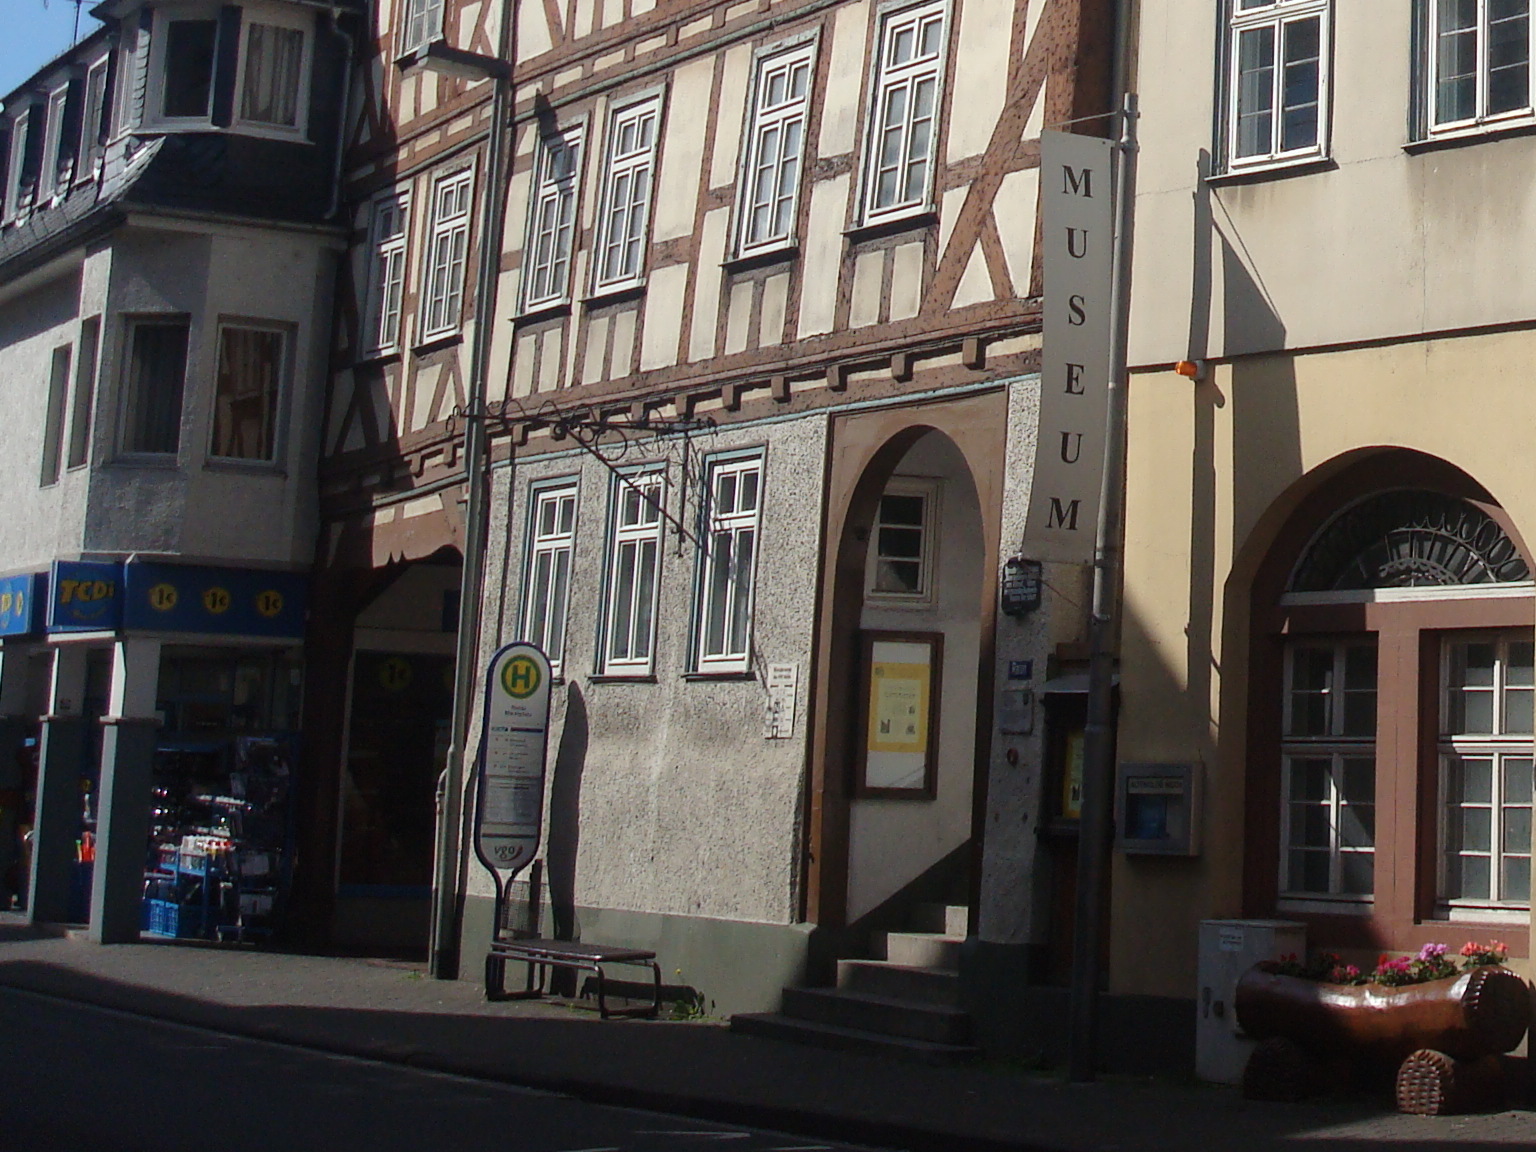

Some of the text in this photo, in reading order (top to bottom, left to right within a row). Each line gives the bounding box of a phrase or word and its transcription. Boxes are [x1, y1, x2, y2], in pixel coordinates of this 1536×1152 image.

[1046, 165, 1093, 531] MUSEUM
[511, 664, 531, 689] H
[494, 846, 515, 860] vgo
